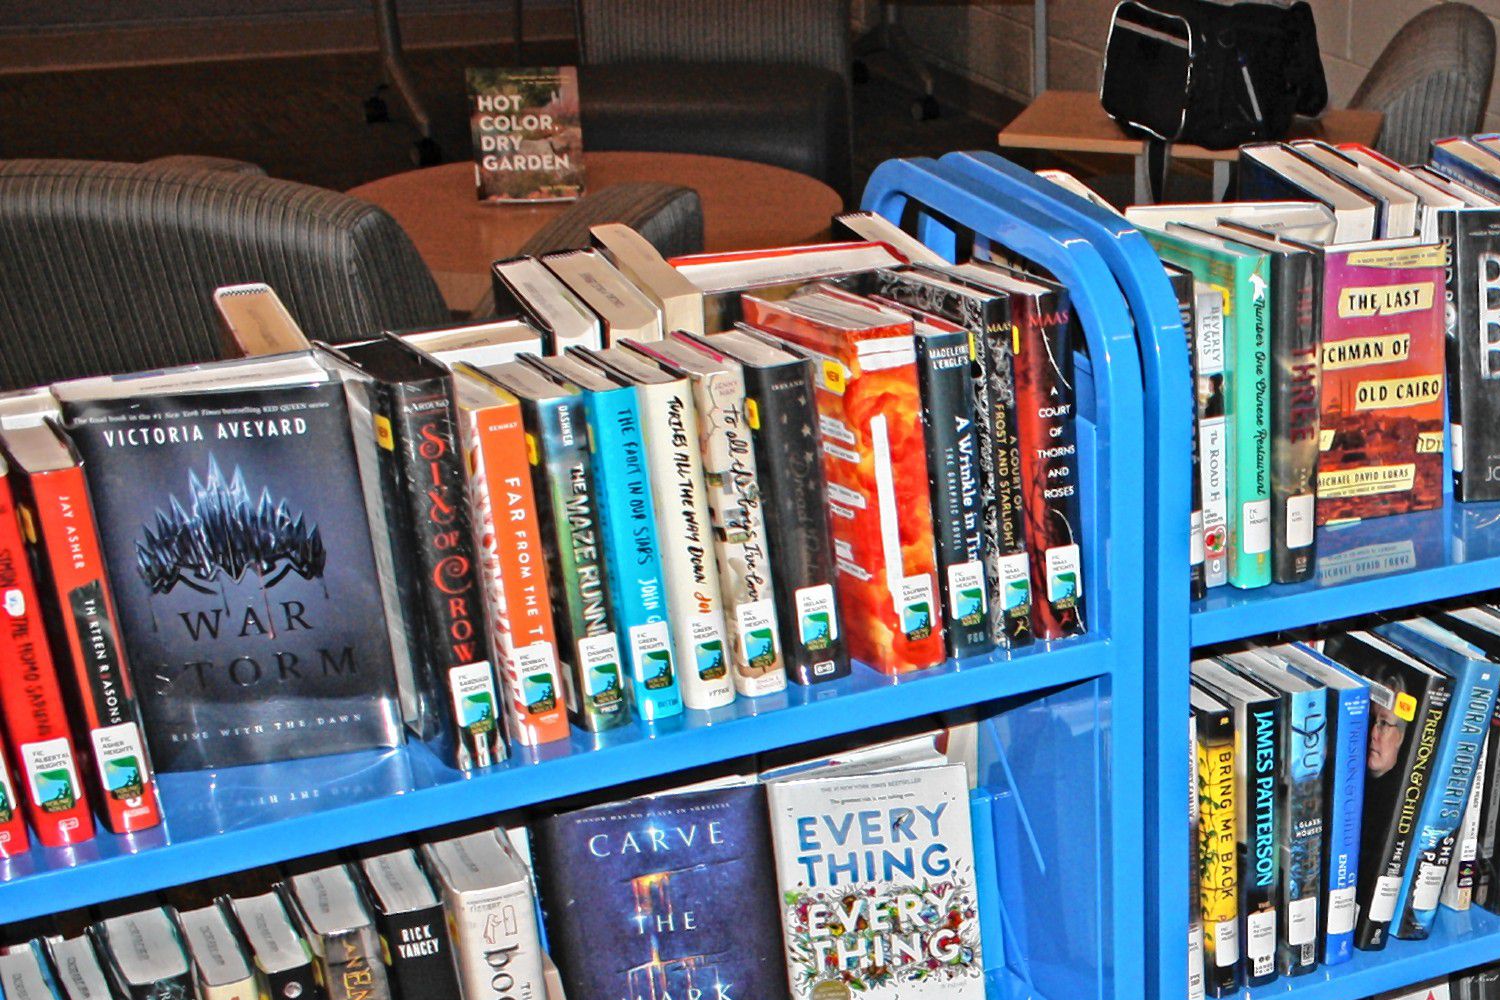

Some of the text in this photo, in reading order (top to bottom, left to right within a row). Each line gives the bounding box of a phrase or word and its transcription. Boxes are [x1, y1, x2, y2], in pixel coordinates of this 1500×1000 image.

[478, 95, 522, 111] HOT
[481, 136, 523, 151] DRY
[483, 154, 569, 171] GARDEN
[1348, 289, 1422, 311] THE LAST
[1029, 311, 1070, 328] MAAS
[1359, 380, 1440, 403] OLD CAIRO
[1038, 404, 1071, 418] COURT
[103, 418, 307, 448] VICTORIA AVEYARD
[1050, 425, 1063, 438] OF
[1036, 444, 1075, 459] THORNS
[994, 403, 1016, 548] FROST AND STARLIGHT
[1047, 467, 1070, 479] AND
[1044, 485, 1075, 500] ROSES
[59, 495, 86, 571] JAY ASHER
[504, 476, 539, 617] FAR FROM THE
[180, 599, 313, 642] WAR
[1443, 686, 1493, 819] NORA ROBERTS
[1254, 711, 1274, 887] JAMES PATTERSON
[796, 802, 949, 852] EVERY
[1218, 751, 1234, 899] BRING ME BACK
[588, 821, 724, 859] CARVE
[796, 843, 951, 888] THING
[636, 910, 697, 936] THE
[808, 889, 953, 937] EVERY
[402, 925, 431, 943] RICK
[399, 938, 439, 959] YANCEY
[810, 928, 961, 972] THING
